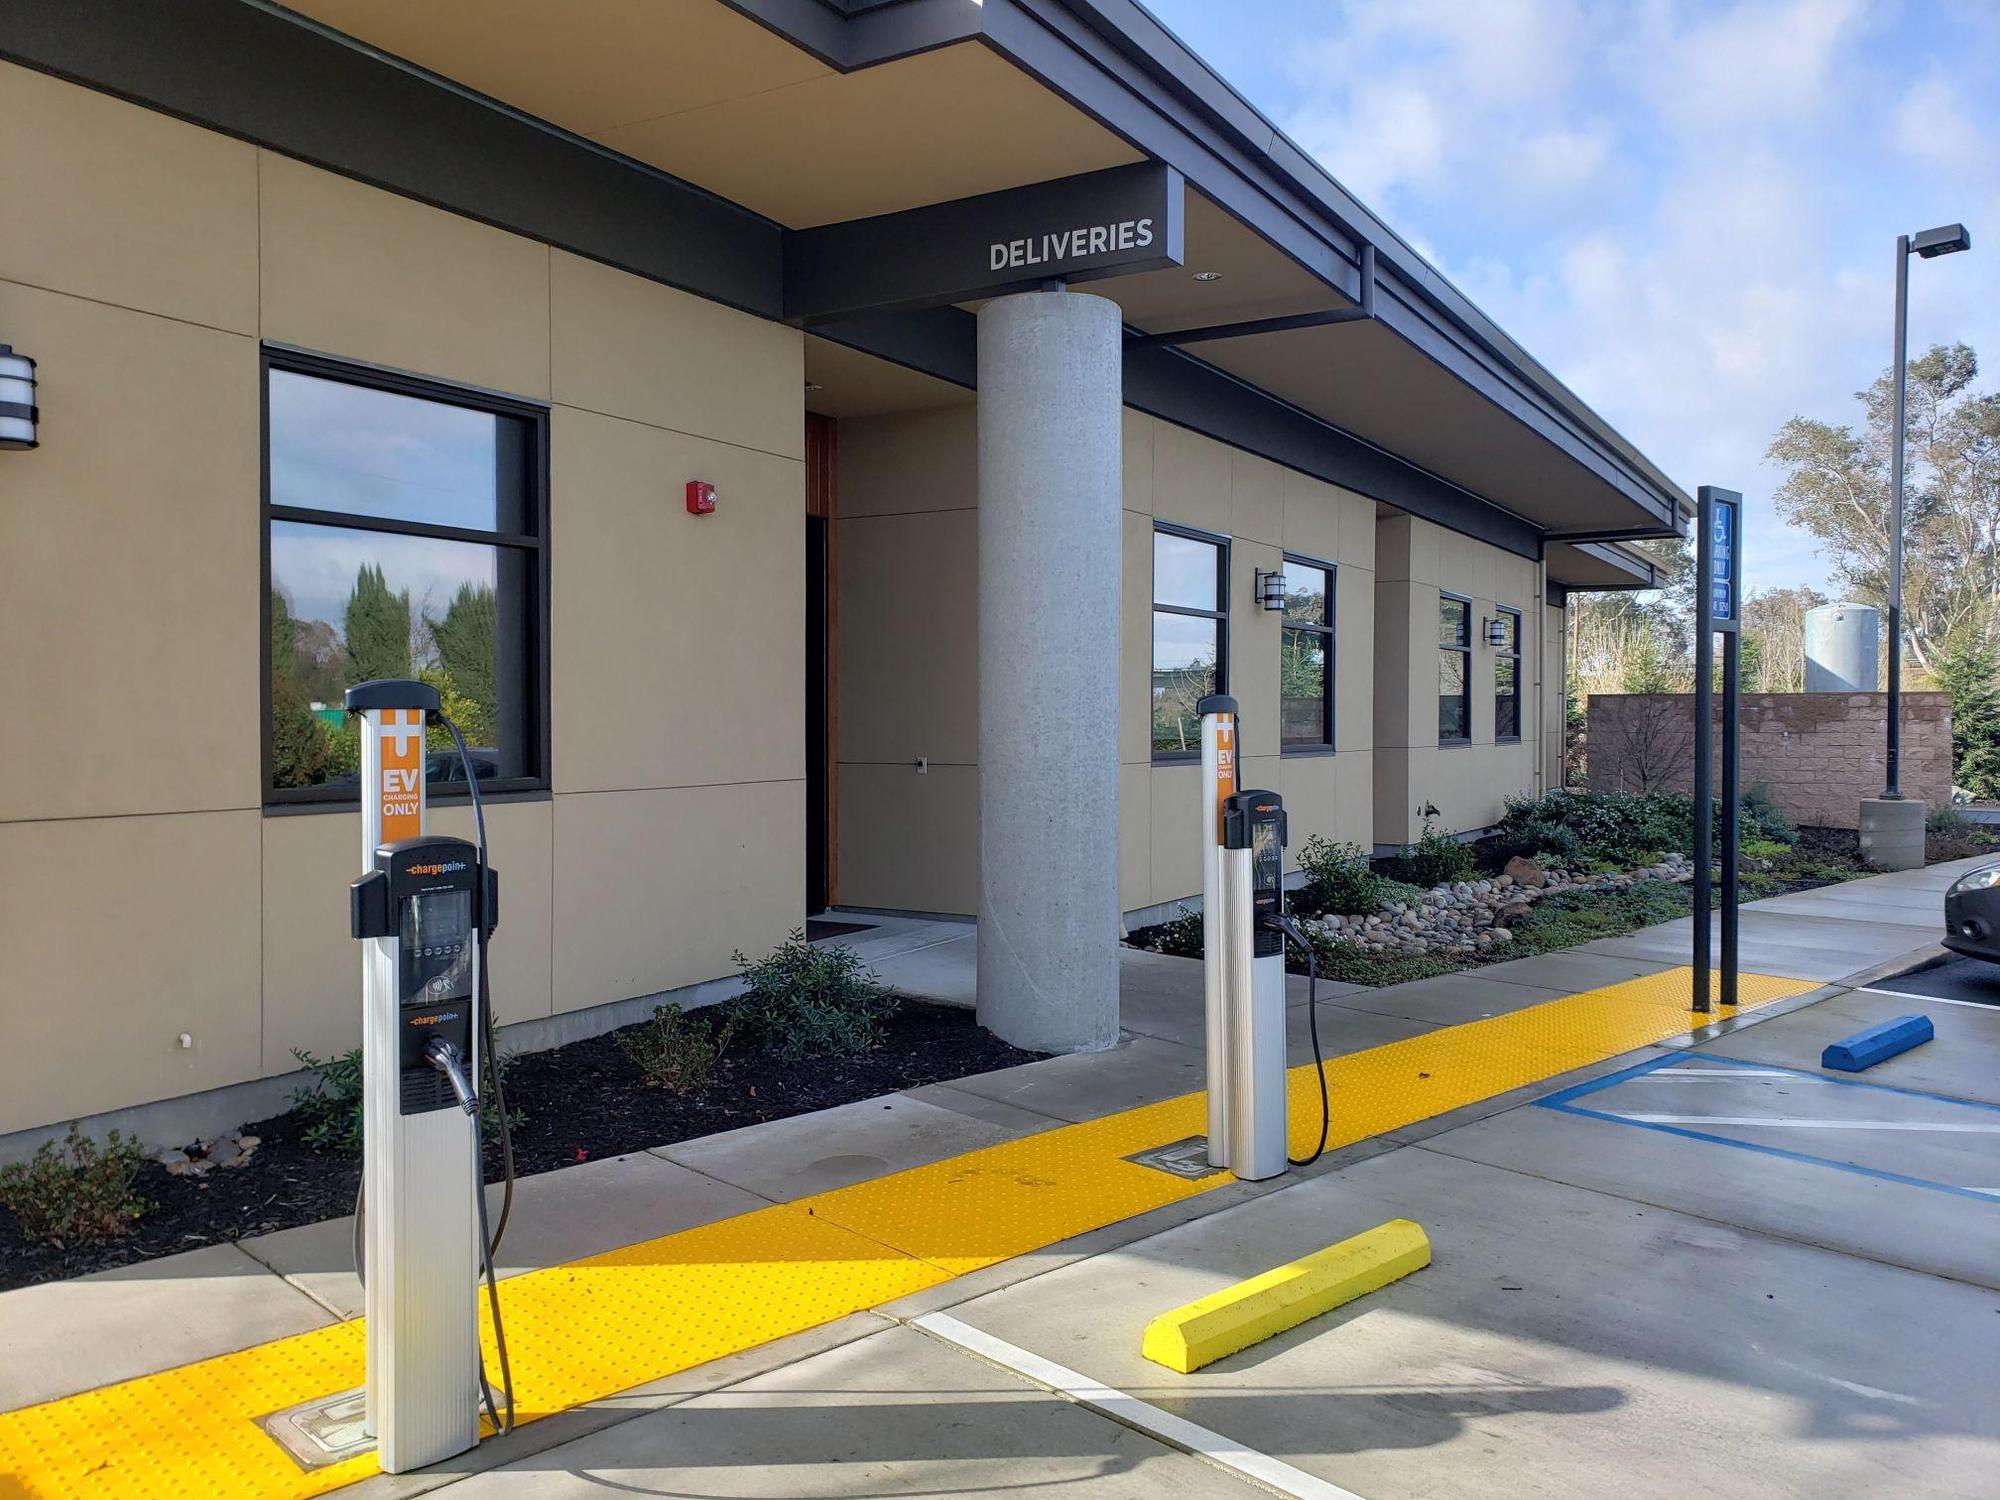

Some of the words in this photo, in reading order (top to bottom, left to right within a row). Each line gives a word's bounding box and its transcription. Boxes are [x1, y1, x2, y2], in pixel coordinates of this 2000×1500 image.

[990, 218, 1153, 271] DELIVERIES
[1217, 750, 1232, 765] EV
[383, 769, 418, 792] EV
[1217, 770, 1232, 779] ONLY
[383, 793, 418, 801] CHARGING
[383, 802, 418, 816] ONLY
[410, 861, 466, 875] chargepoint
